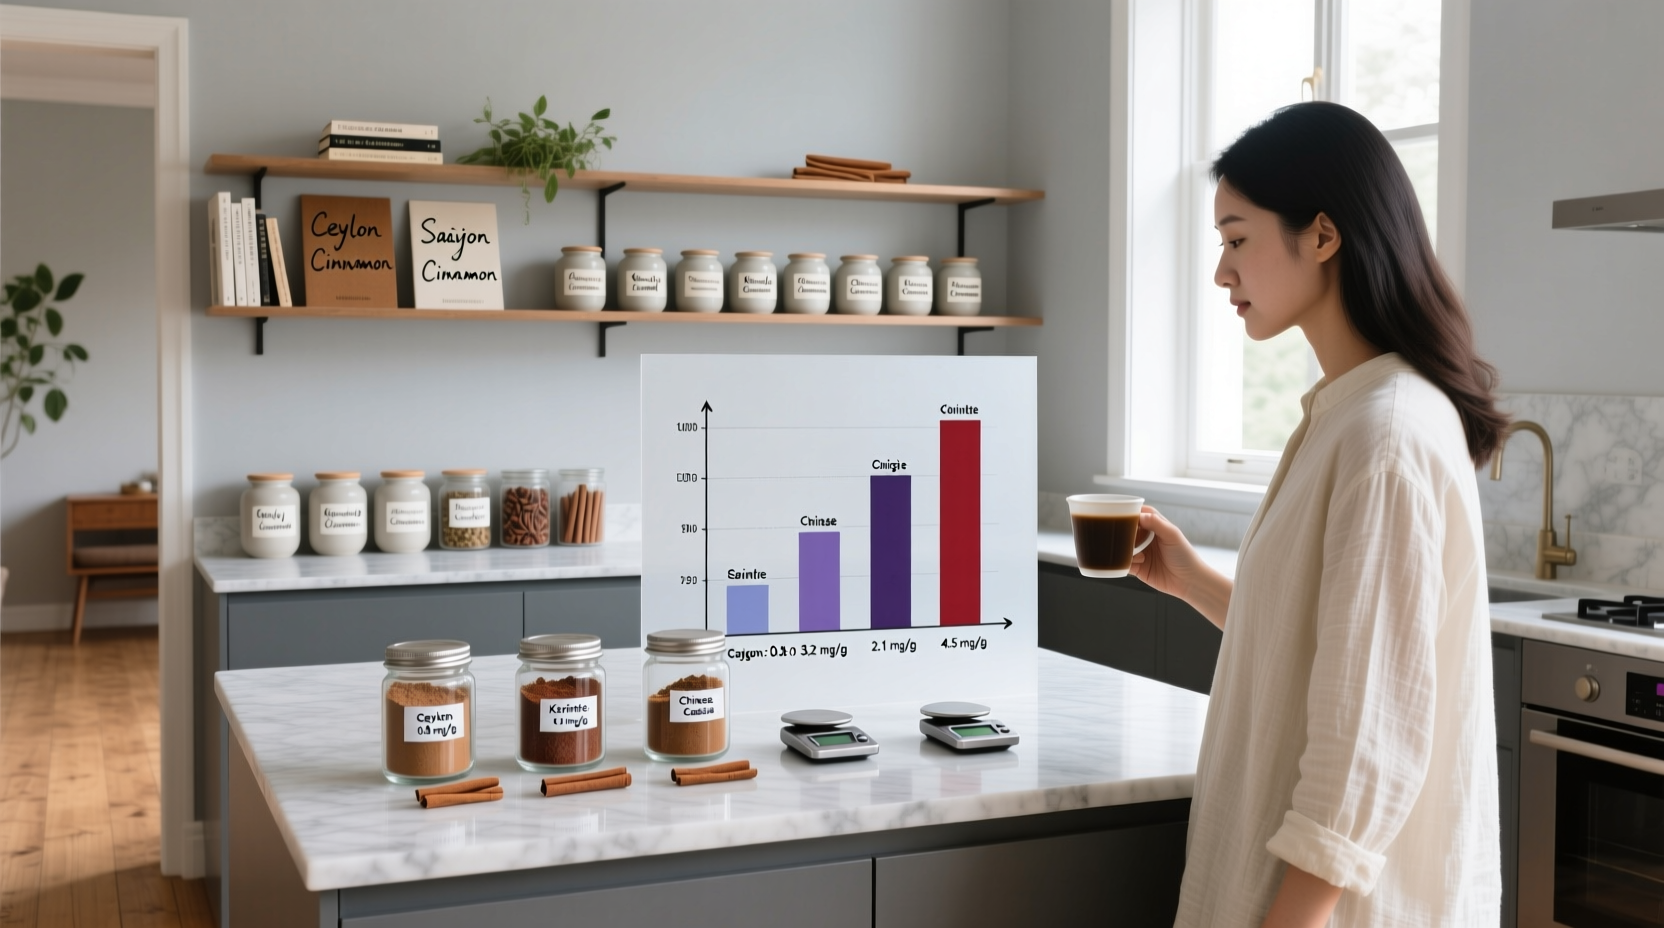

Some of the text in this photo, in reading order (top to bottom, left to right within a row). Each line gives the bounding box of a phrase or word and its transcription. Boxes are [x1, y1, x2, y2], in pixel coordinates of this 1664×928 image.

[311, 211, 382, 251] Ceylon
[820, 642, 848, 659] mg/g
[871, 638, 917, 653] 2.1 mg/g
[940, 636, 988, 651] 4.5 mg/g
